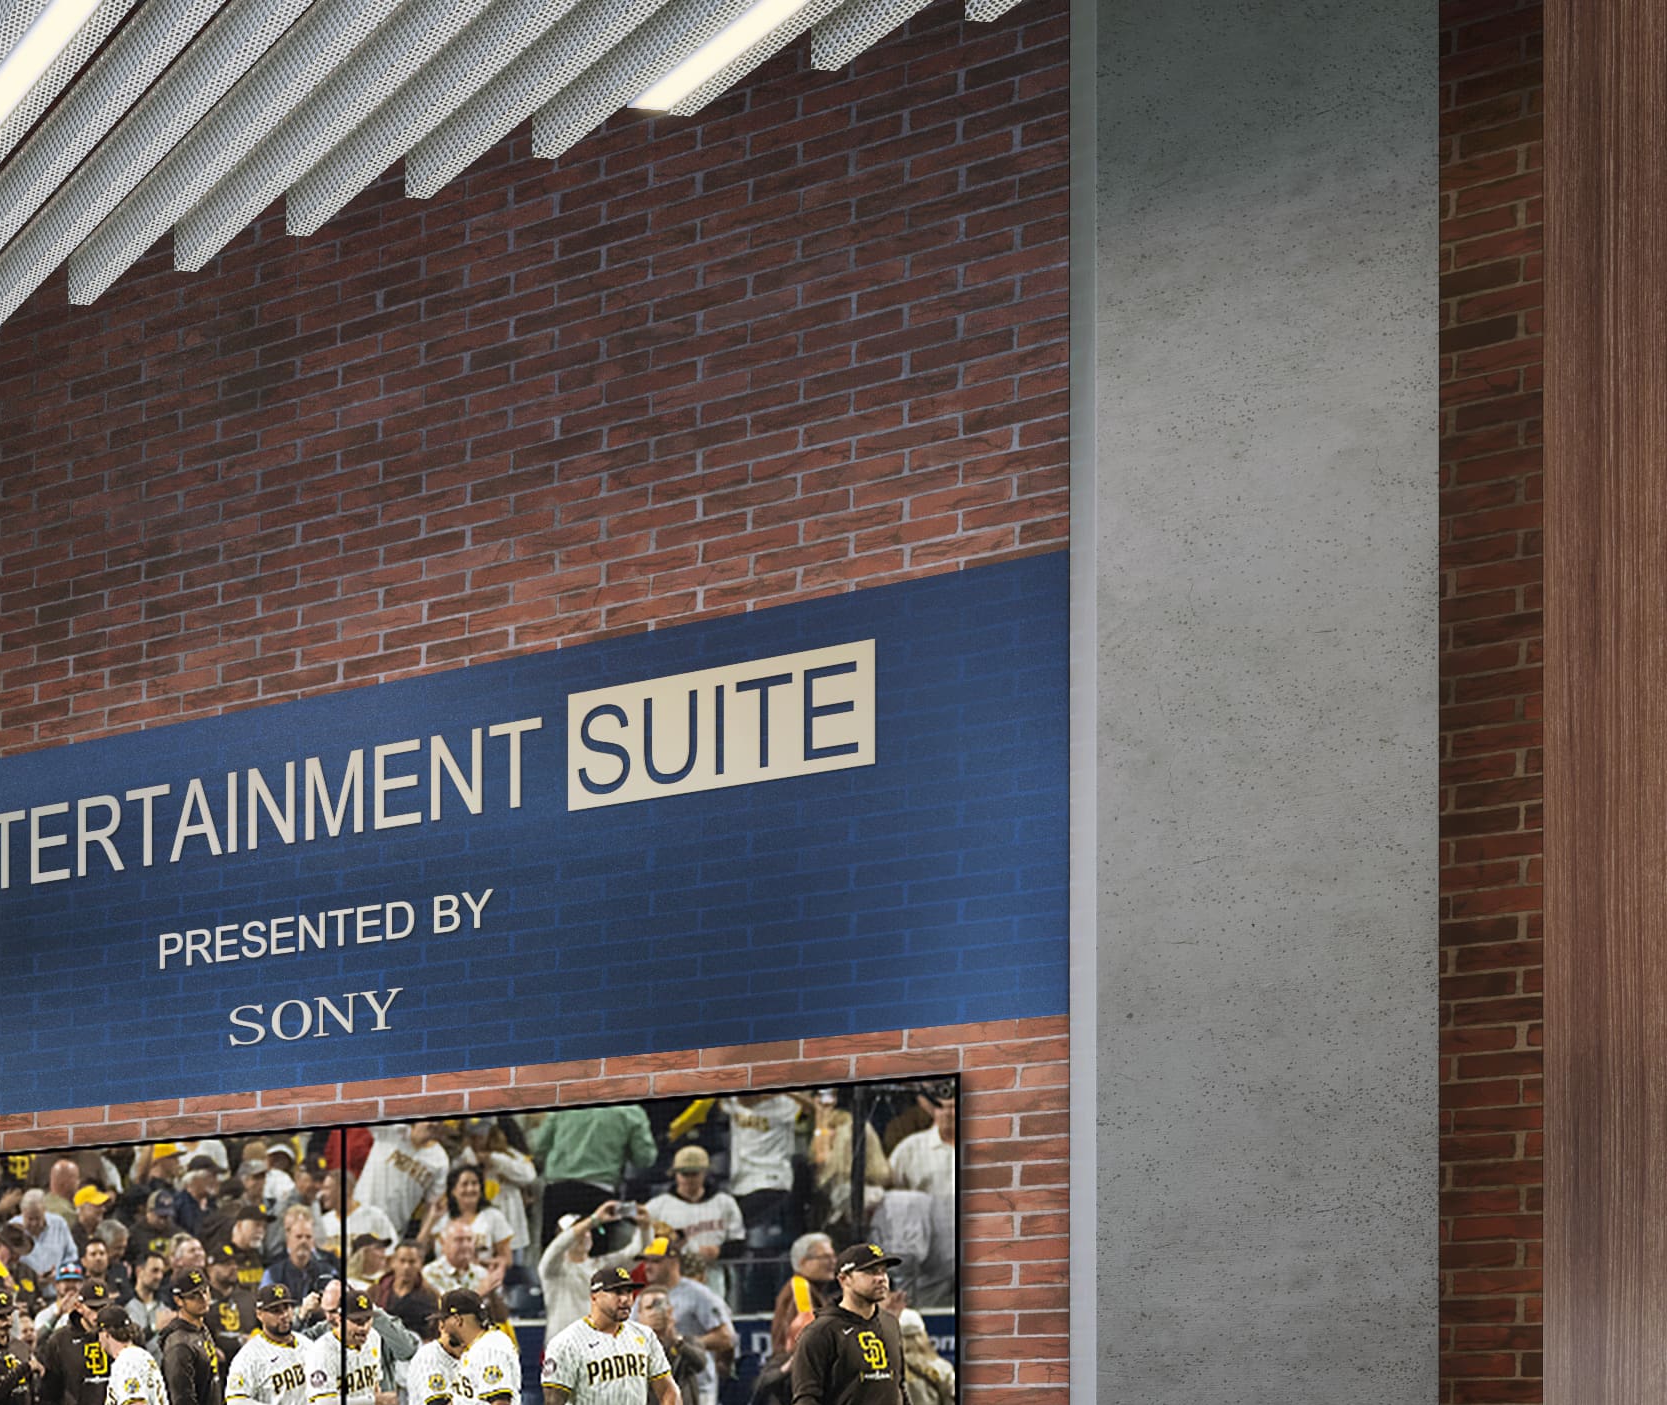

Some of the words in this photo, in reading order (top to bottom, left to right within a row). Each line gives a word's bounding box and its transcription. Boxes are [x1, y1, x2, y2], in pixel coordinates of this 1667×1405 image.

[577, 660, 860, 795] SUITE
[158, 900, 416, 970] PRESENTED
[433, 888, 495, 935] BY
[228, 987, 405, 1047] SONY
[586, 1353, 653, 1387] PADRE
[858, 1331, 889, 1370] SD
